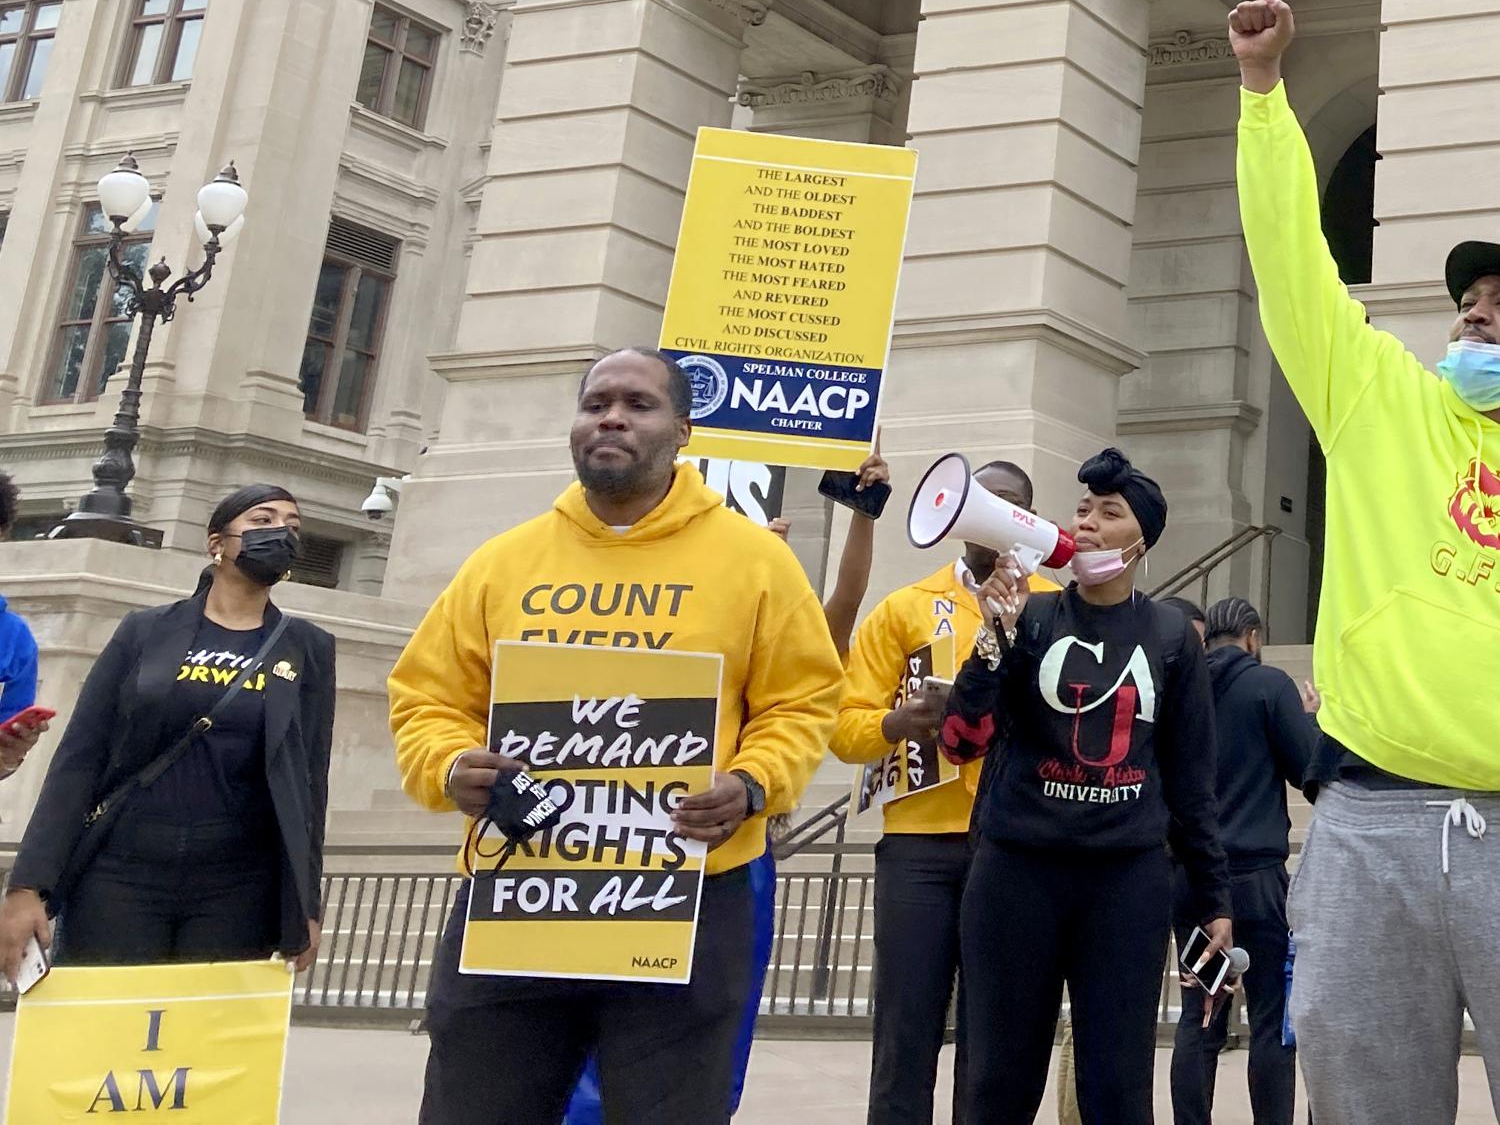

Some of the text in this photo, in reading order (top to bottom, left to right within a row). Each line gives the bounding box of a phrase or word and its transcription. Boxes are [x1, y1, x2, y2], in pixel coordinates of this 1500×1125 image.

[757, 168, 847, 188] THE LARGEST
[744, 185, 857, 206] AND THE OLDEST
[753, 203, 843, 222] THE BADDEST
[733, 219, 856, 240] AND THE BOLDEST
[733, 236, 850, 258] THE MOST LOVED
[728, 253, 845, 274] THE MOST HATED
[722, 269, 846, 292] THE MOST FEARED
[733, 289, 829, 308] AND REVERED
[718, 305, 841, 327] THE MOST CUSSED
[722, 324, 828, 344] AND DISCUSSED
[675, 336, 865, 364] CIVIL RIGHTS ORGANIZATION
[742, 362, 867, 384] SPELMAN COLLEGE
[730, 376, 870, 420] NAACP
[771, 417, 823, 431] CHAPTER
[521, 582, 694, 618] COUNT
[571, 693, 647, 728] WE
[500, 730, 709, 768] DEMAND
[534, 777, 690, 816] OTING
[492, 874, 688, 916] FOR ALL
[631, 956, 678, 969] NAACP
[141, 1009, 168, 1052] I
[86, 1066, 193, 1114] AM
